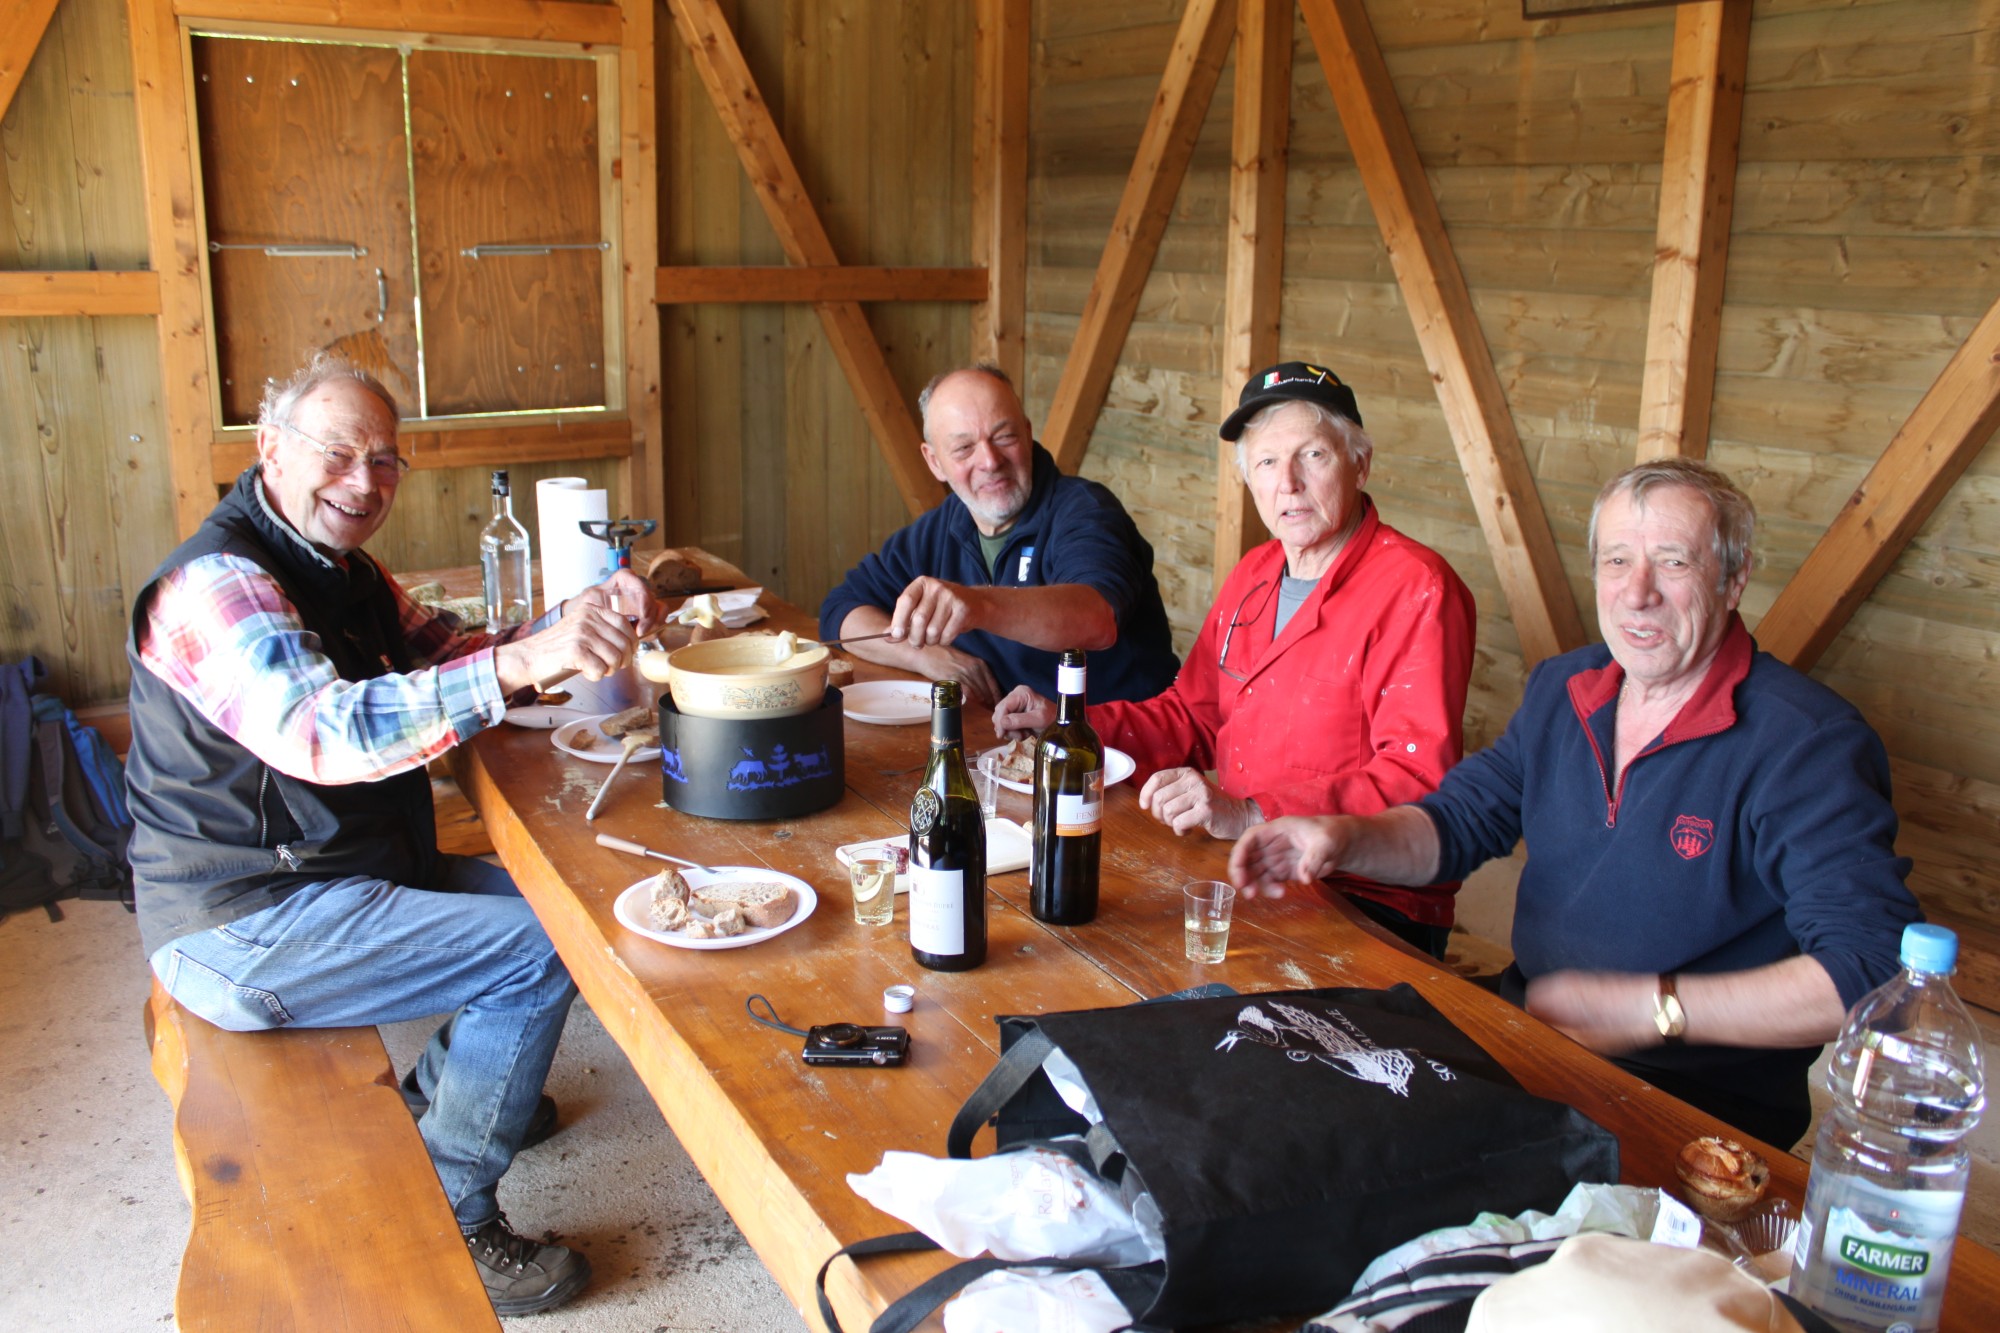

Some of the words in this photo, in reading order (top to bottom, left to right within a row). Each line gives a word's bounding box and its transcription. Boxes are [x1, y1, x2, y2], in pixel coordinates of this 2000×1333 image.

[1679, 818, 1711, 829] OUTDOOR
[1845, 1239, 1924, 1272] FARMER
[1835, 1267, 1920, 1301] MINERAL
